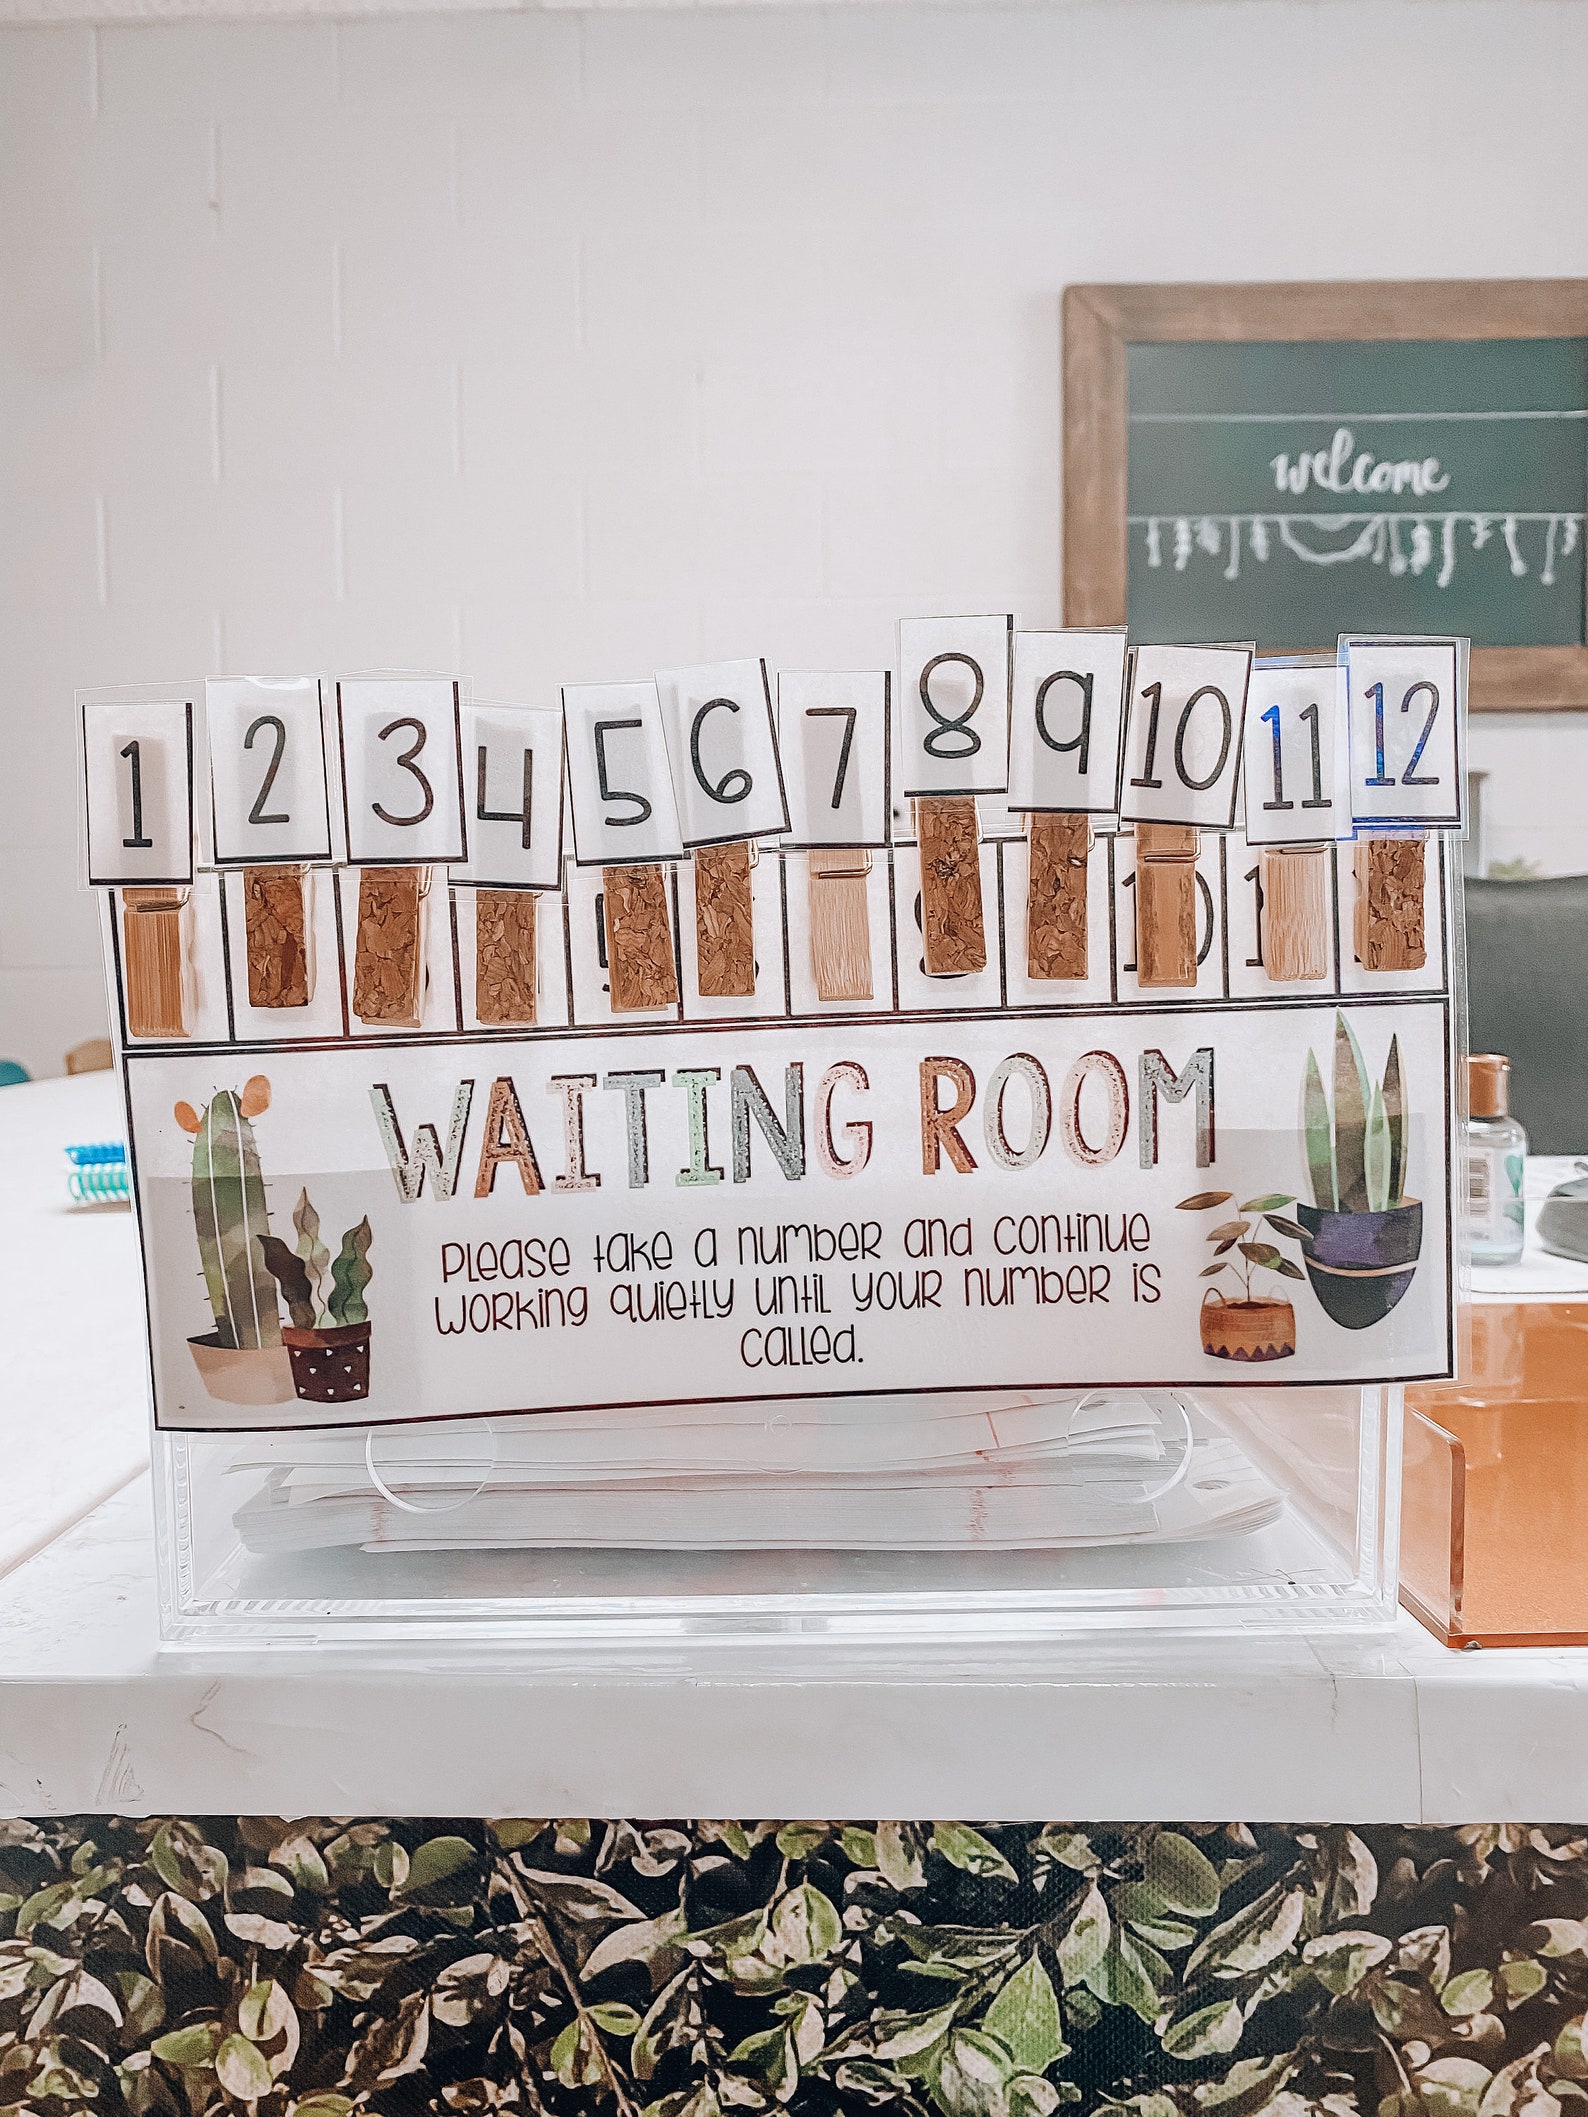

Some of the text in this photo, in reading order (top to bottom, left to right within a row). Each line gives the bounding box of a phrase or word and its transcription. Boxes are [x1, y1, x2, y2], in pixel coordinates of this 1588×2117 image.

[1270, 427, 1449, 496] welcome
[690, 698, 752, 803] 6
[806, 708, 856, 809] 7
[920, 653, 984, 759] 8
[1130, 681, 1231, 790] 10
[1261, 704, 1332, 810] 11
[1365, 681, 1439, 786] 12
[120, 741, 152, 847] 1
[244, 716, 290, 824] 2
[372, 718, 433, 826] 3
[477, 746, 533, 849] 4
[594, 719, 652, 826] 5
[368, 1047, 1216, 1204] WAITING ROOM
[593, 1231, 673, 1272] take
[694, 1228, 718, 1267] a
[904, 1217, 973, 1258] and
[993, 1212, 1150, 1255] continue
[610, 1278, 734, 1323] quietly
[755, 1273, 832, 1316] until
[852, 1269, 943, 1312] your
[1133, 1262, 1162, 1303] is
